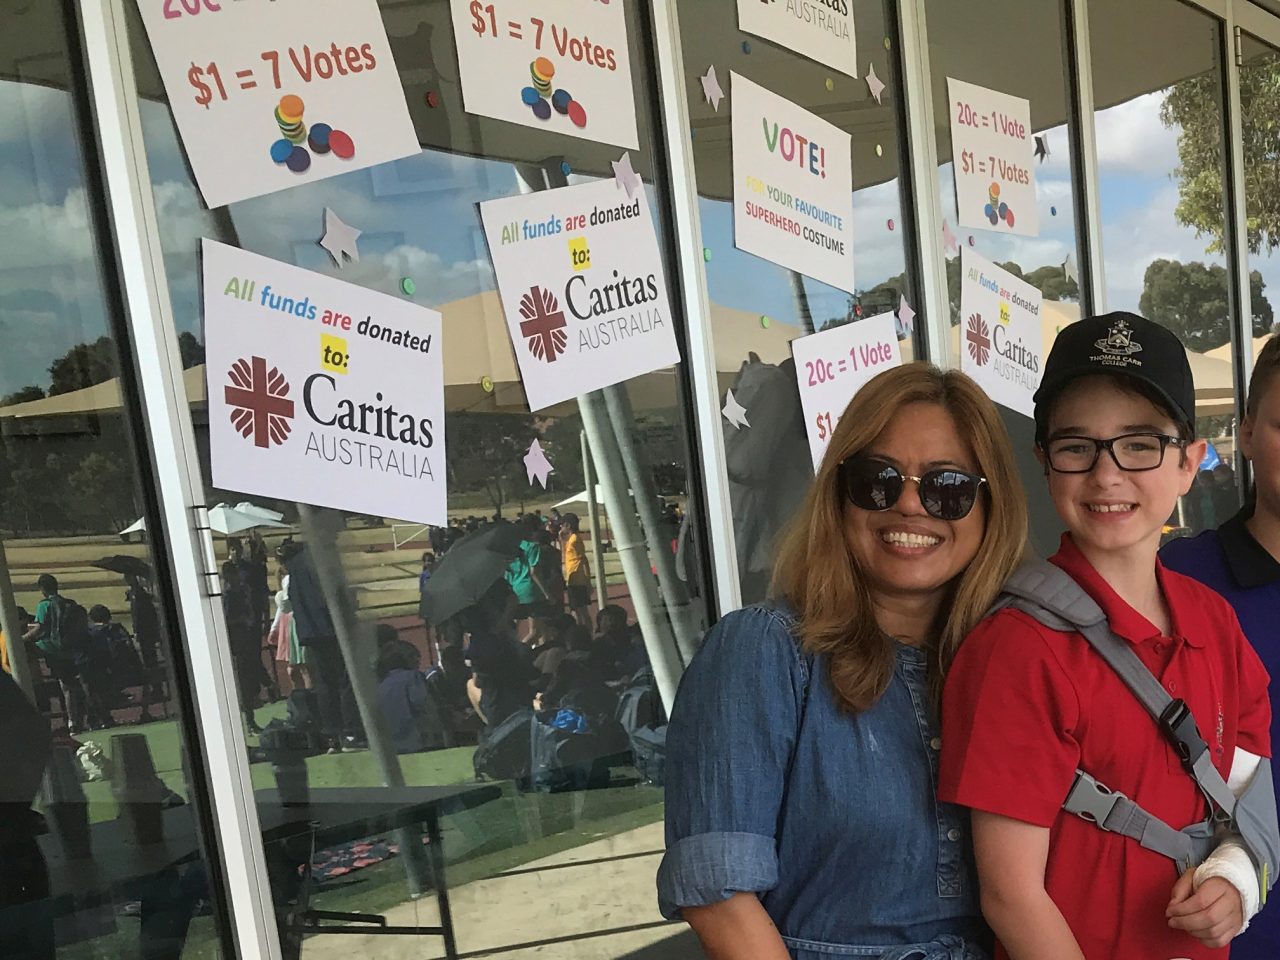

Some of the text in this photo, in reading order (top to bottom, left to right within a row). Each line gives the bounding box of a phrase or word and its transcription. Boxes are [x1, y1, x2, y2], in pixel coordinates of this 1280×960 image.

[469, 0, 498, 38] $1
[530, 17, 544, 50] 7
[551, 23, 617, 71] Votes
[786, 0, 850, 41] AUSTRALIA
[188, 61, 228, 109] $1
[261, 51, 281, 89] 7
[288, 42, 377, 83] Votes
[957, 101, 979, 129] 20c
[991, 111, 998, 133] 1
[999, 113, 1026, 140] Vote
[763, 116, 826, 179] VOTE!
[961, 147, 975, 175] $1
[988, 156, 996, 178] 7
[998, 158, 1030, 185] Votes
[501, 198, 640, 246] All funds are donated
[745, 201, 845, 256] SUPERHERO COSTUME
[767, 185, 793, 208] YOUR
[795, 197, 844, 231] FAVOURITE
[572, 248, 590, 266] to:
[223, 276, 432, 353] All funds are donated
[564, 269, 658, 320] Caritas
[979, 272, 999, 294] funds
[999, 287, 1011, 300] are
[1011, 292, 1039, 316] donated
[579, 308, 664, 352] AUSTRALIA
[993, 324, 1039, 374] Caritas
[323, 345, 350, 368] to:
[805, 358, 835, 387] 20c
[849, 347, 858, 371] 1
[860, 341, 892, 368] Vote
[993, 358, 1039, 391] AUSTRALIA
[1089, 354, 1143, 366] THOMAS CARR
[303, 373, 433, 448] Caritas
[816, 411, 832, 441] $1
[304, 431, 435, 482] AUSTRALIA
